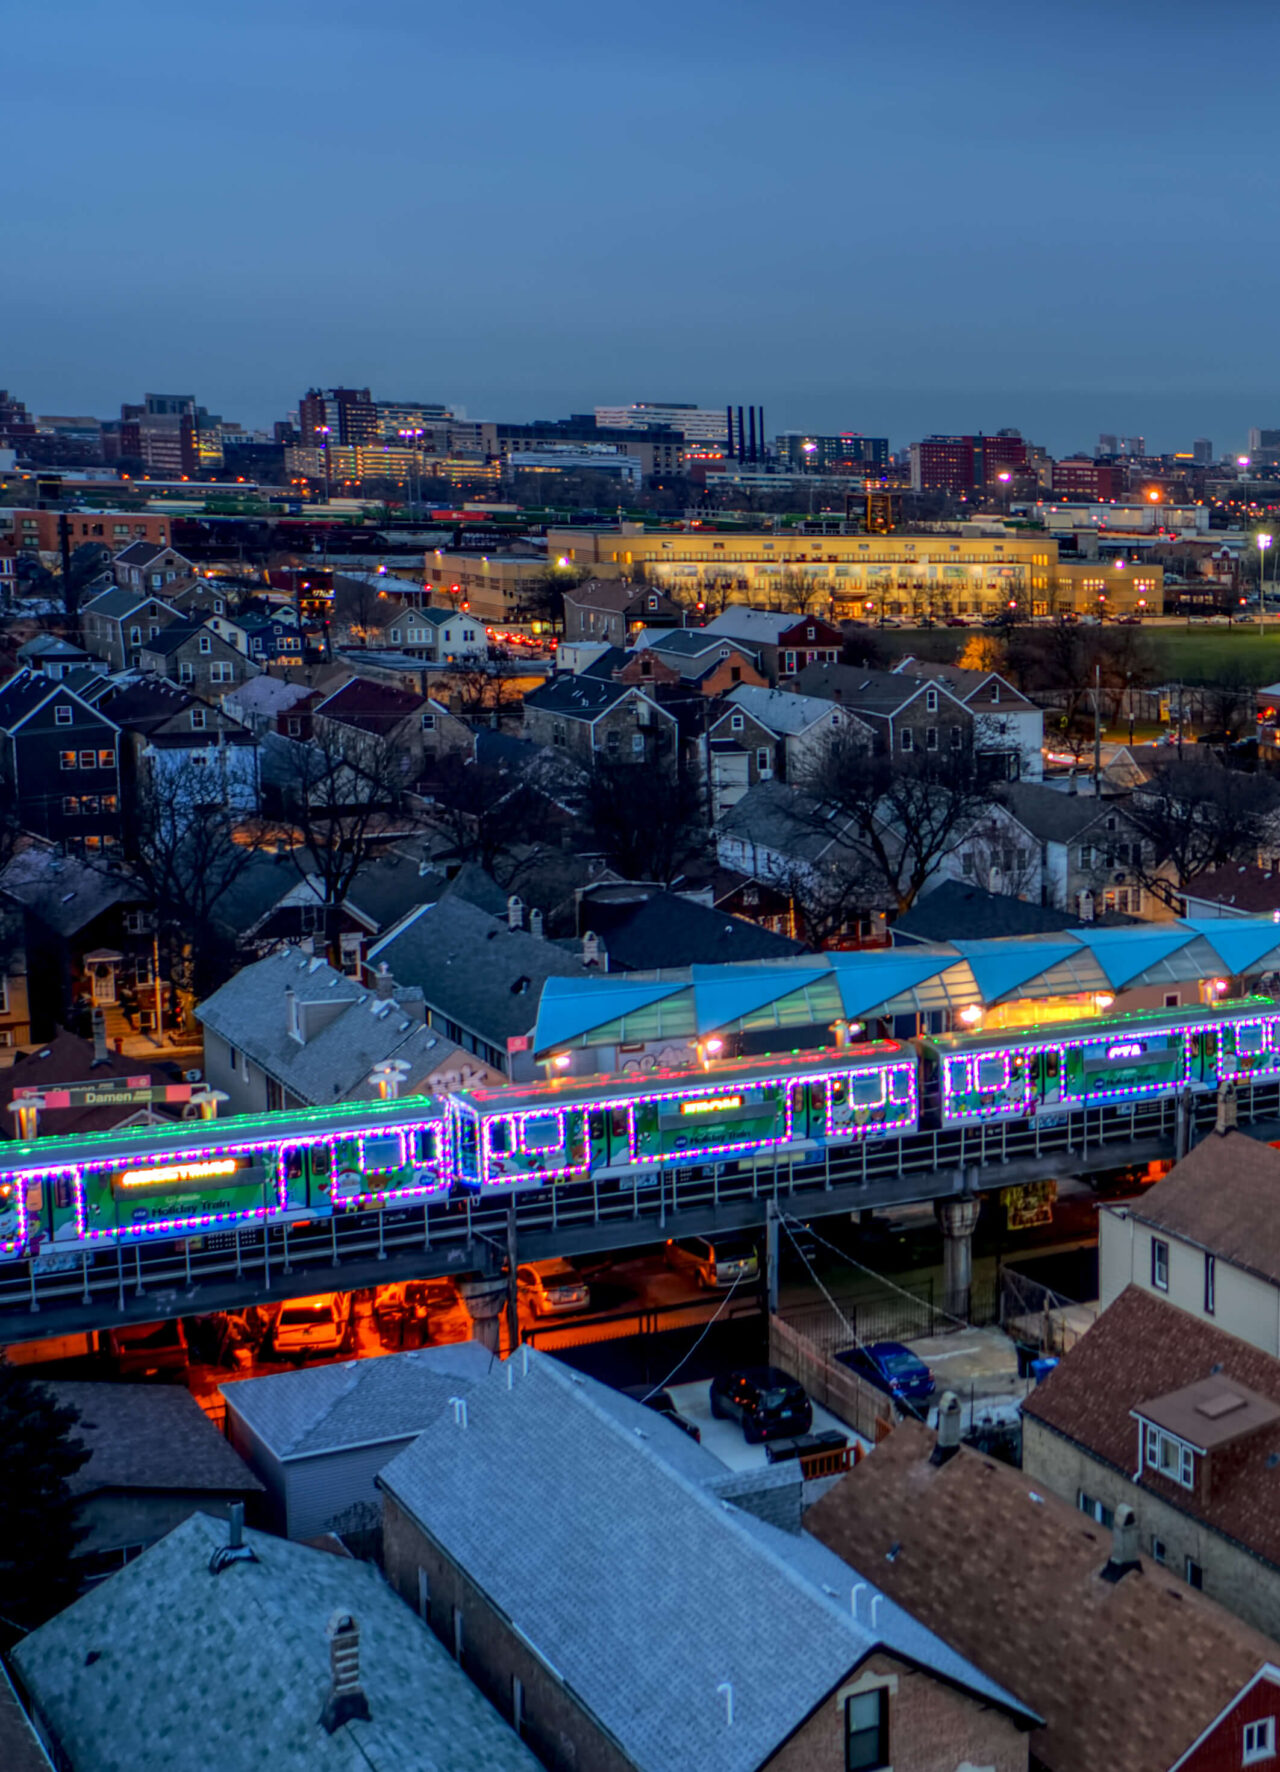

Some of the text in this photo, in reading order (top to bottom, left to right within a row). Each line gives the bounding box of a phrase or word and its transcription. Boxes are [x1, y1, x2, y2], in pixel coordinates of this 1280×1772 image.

[85, 1092, 132, 1104] Damen
[151, 1202, 198, 1217] Holiday
[201, 1199, 231, 1211] Train
